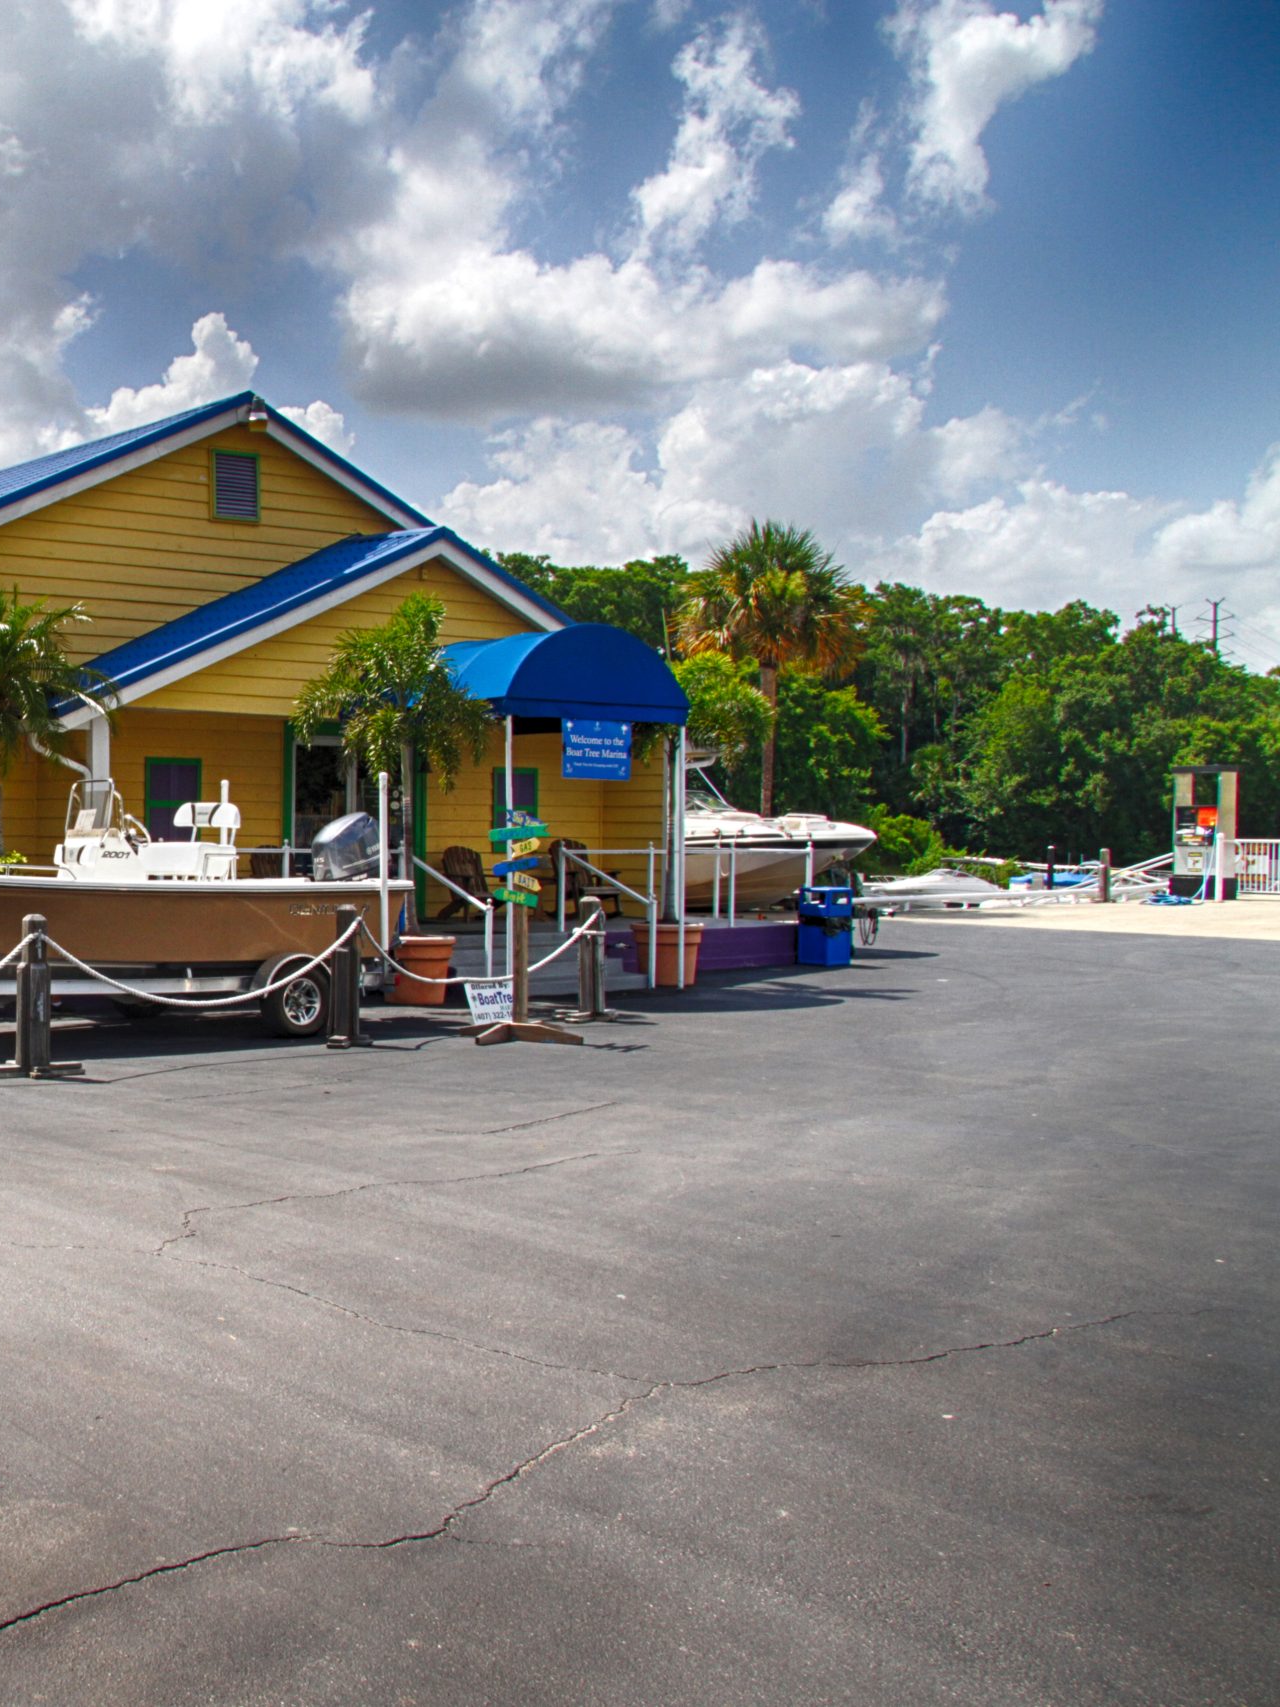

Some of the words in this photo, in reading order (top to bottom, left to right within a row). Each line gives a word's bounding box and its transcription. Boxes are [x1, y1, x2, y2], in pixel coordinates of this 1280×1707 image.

[570, 734, 602, 745] Welcome
[613, 737, 624, 746] the
[566, 747, 583, 757] Boat
[584, 748, 600, 757] Tree
[602, 749, 627, 759] Marina
[520, 841, 532, 853] GAS
[101, 851, 130, 859] 2001
[477, 991, 512, 1005] BoatTre
